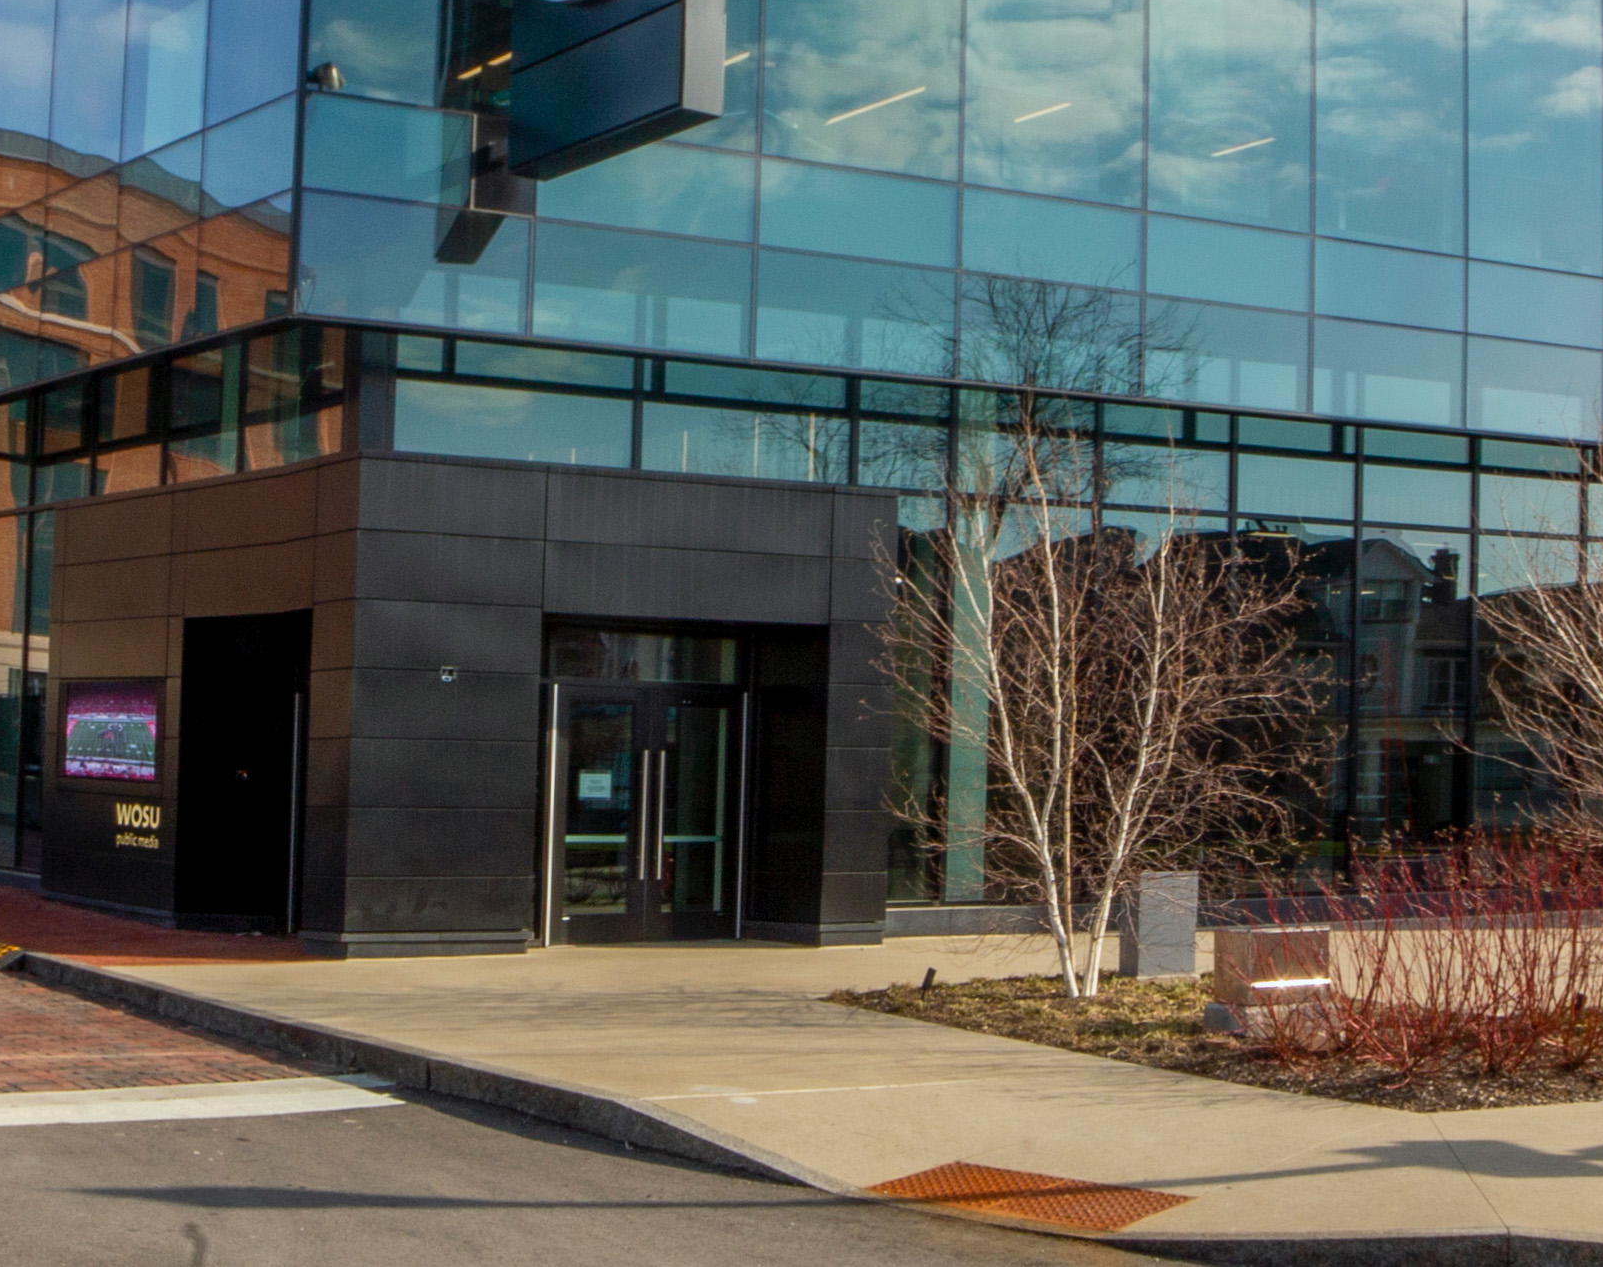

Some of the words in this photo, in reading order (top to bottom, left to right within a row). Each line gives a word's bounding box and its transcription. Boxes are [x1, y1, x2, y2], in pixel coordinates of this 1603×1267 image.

[116, 802, 161, 829] WOSU
[116, 832, 137, 848] public
[138, 835, 159, 849] media
